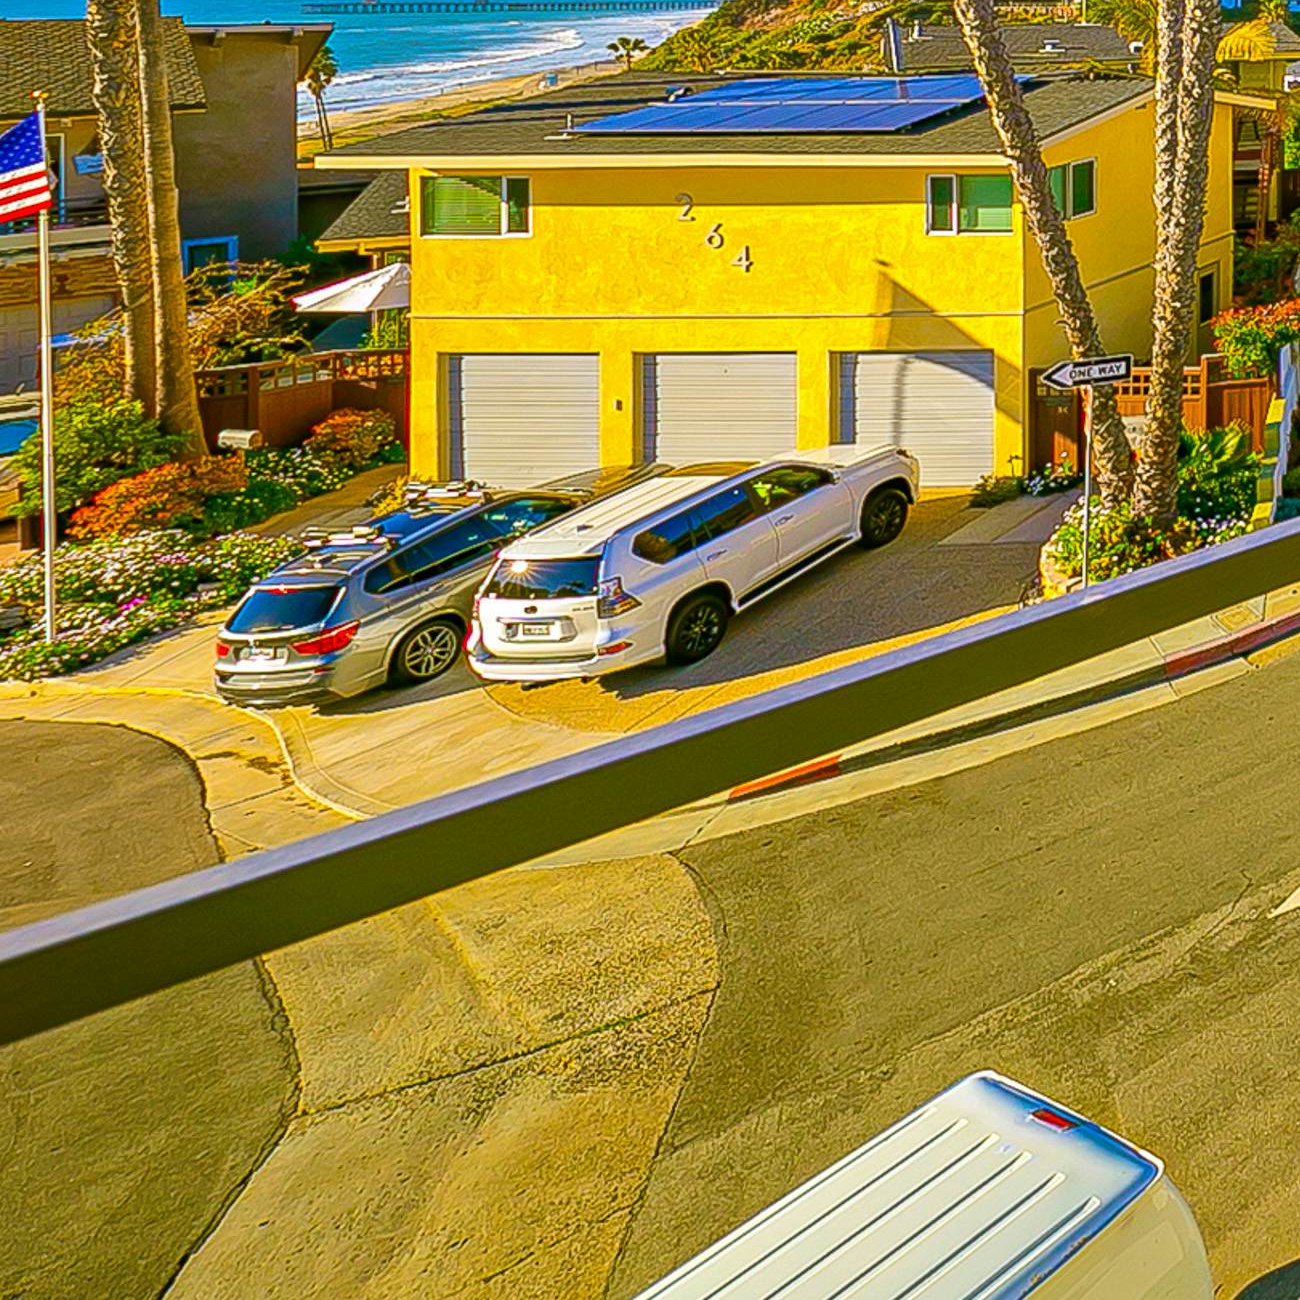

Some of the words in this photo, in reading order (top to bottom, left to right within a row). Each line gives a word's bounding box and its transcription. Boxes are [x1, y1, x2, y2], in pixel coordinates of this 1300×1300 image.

[674, 192, 754, 273] 264
[1069, 367, 1093, 380] ONE
[1098, 363, 1122, 376] WAY
